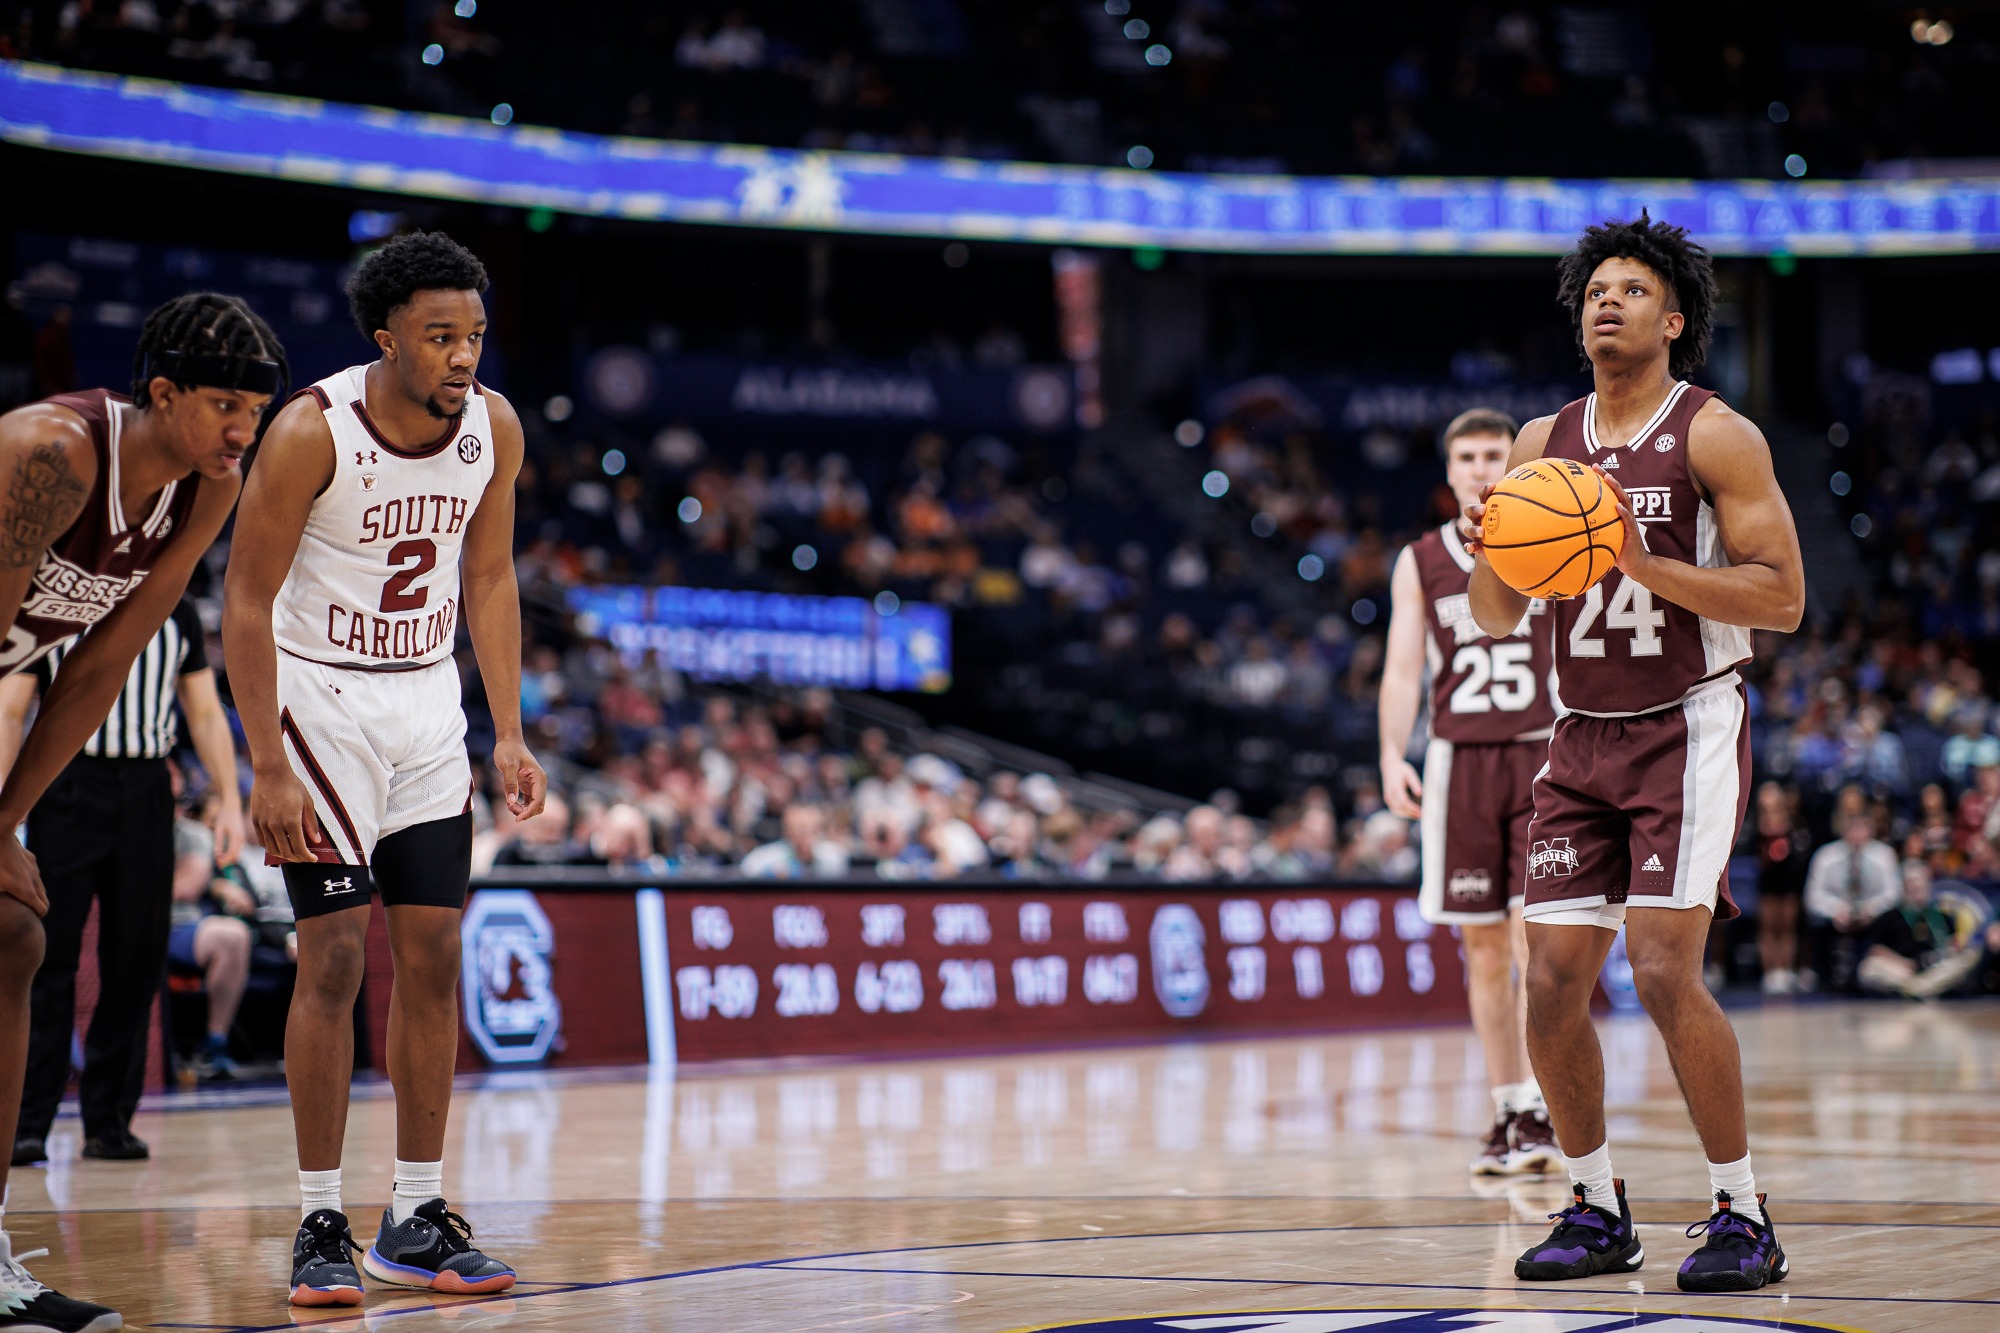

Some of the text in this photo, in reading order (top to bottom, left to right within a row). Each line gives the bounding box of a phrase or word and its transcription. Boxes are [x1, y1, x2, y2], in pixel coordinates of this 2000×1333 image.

[459, 436, 481, 463] SEC
[1656, 435, 1675, 451] SEC
[1537, 473, 1552, 483] NXT
[359, 494, 468, 544] SOUTH
[379, 538, 437, 613] 2
[327, 597, 456, 659] CAROLINA
[1569, 574, 1666, 658] 24
[1450, 642, 1537, 714] 25
[1535, 850, 1567, 865] STATE
[1641, 863, 1665, 872] adidas
